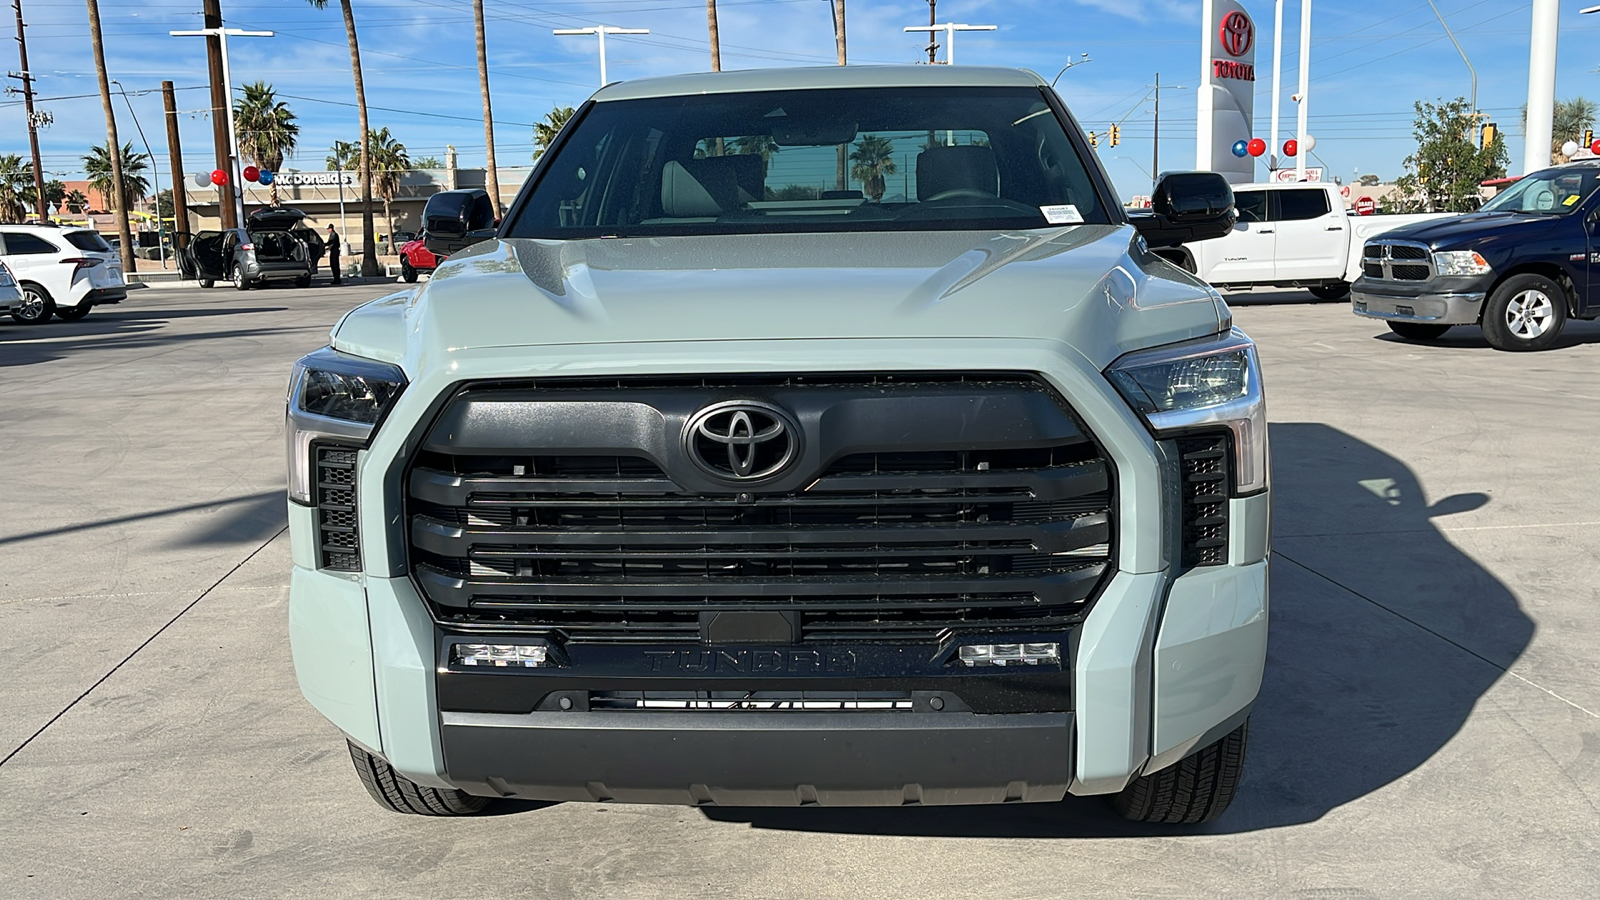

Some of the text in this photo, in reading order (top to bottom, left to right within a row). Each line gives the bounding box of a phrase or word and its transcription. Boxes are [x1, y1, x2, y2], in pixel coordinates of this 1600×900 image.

[1213, 60, 1255, 81] TOYOTA
[275, 174, 348, 185] McDonalds
[643, 650, 857, 672] TUNDRA
